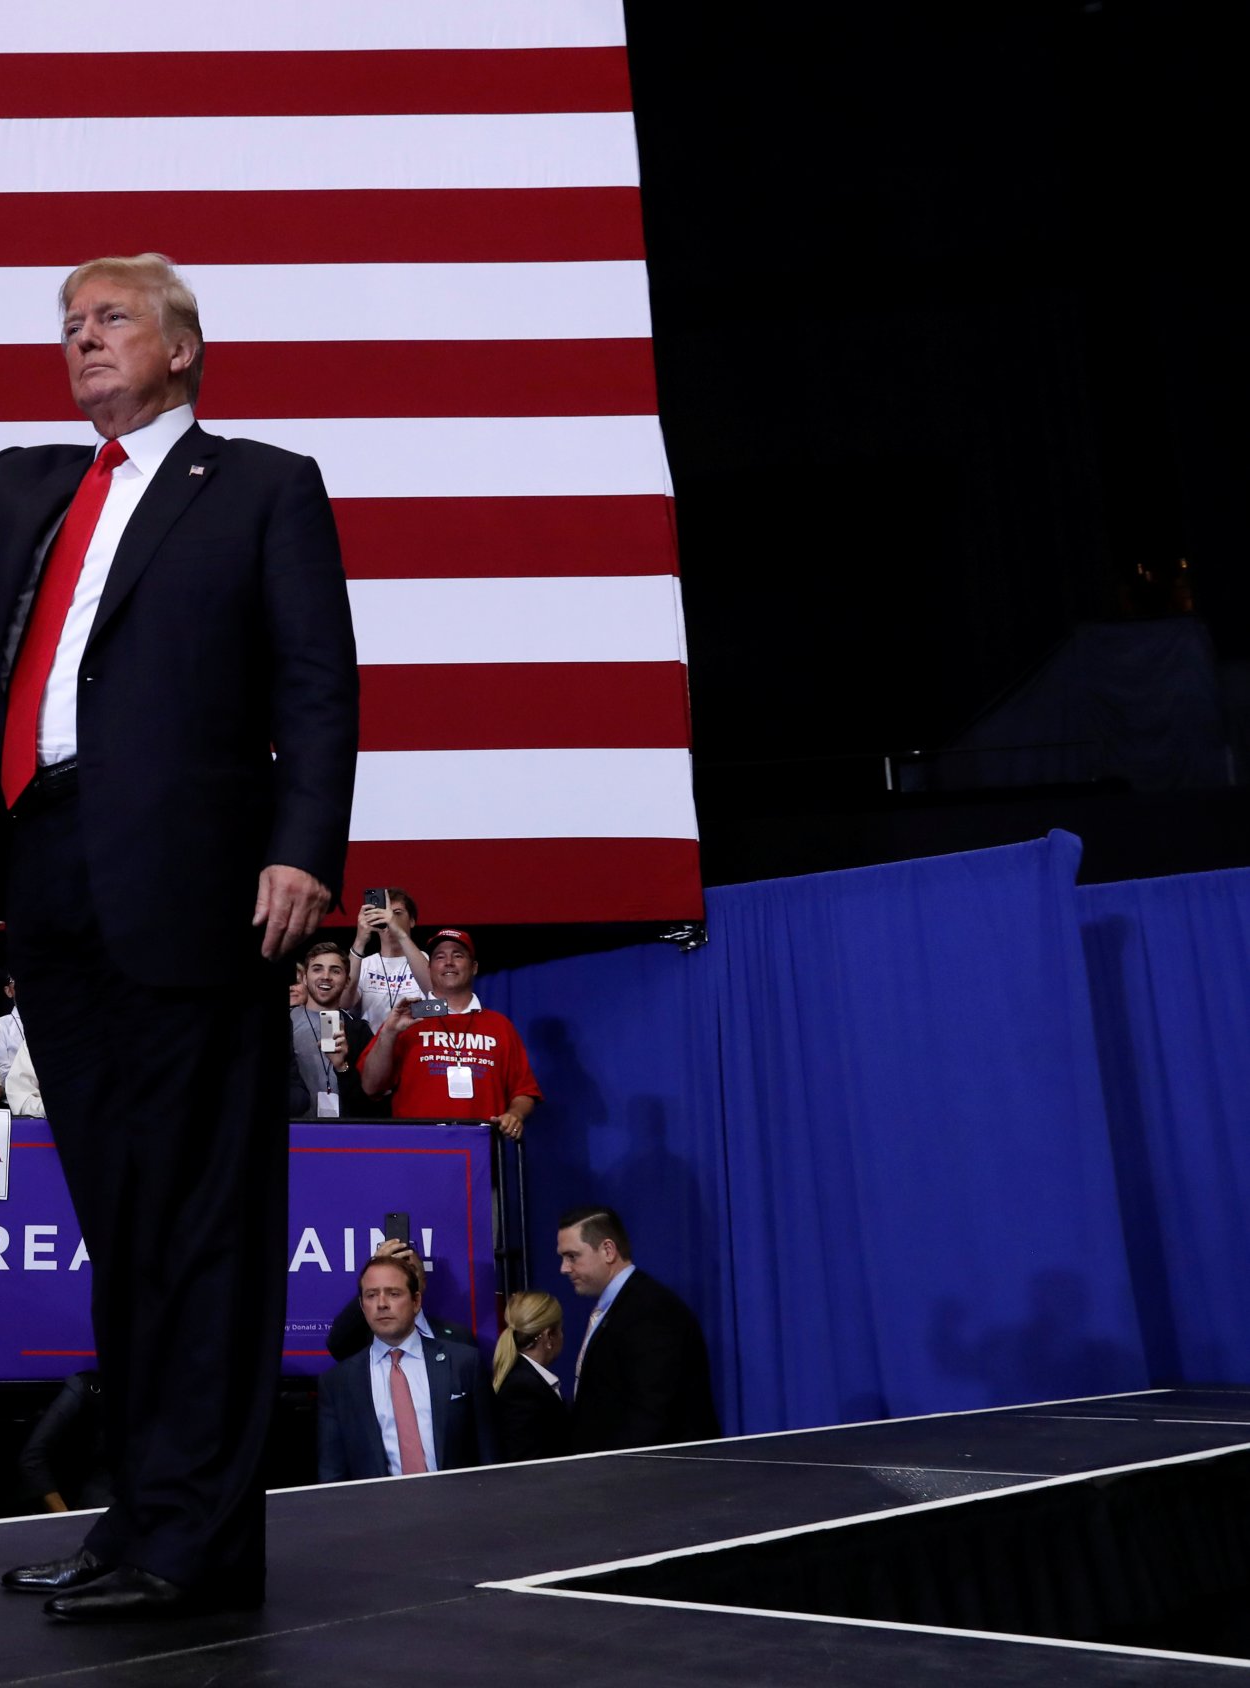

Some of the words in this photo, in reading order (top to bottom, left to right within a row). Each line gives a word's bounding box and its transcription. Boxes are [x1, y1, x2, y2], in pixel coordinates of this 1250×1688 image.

[419, 1031, 497, 1051] TRUMP
[420, 1054, 434, 1062] FOR
[478, 1058, 495, 1067] 2016
